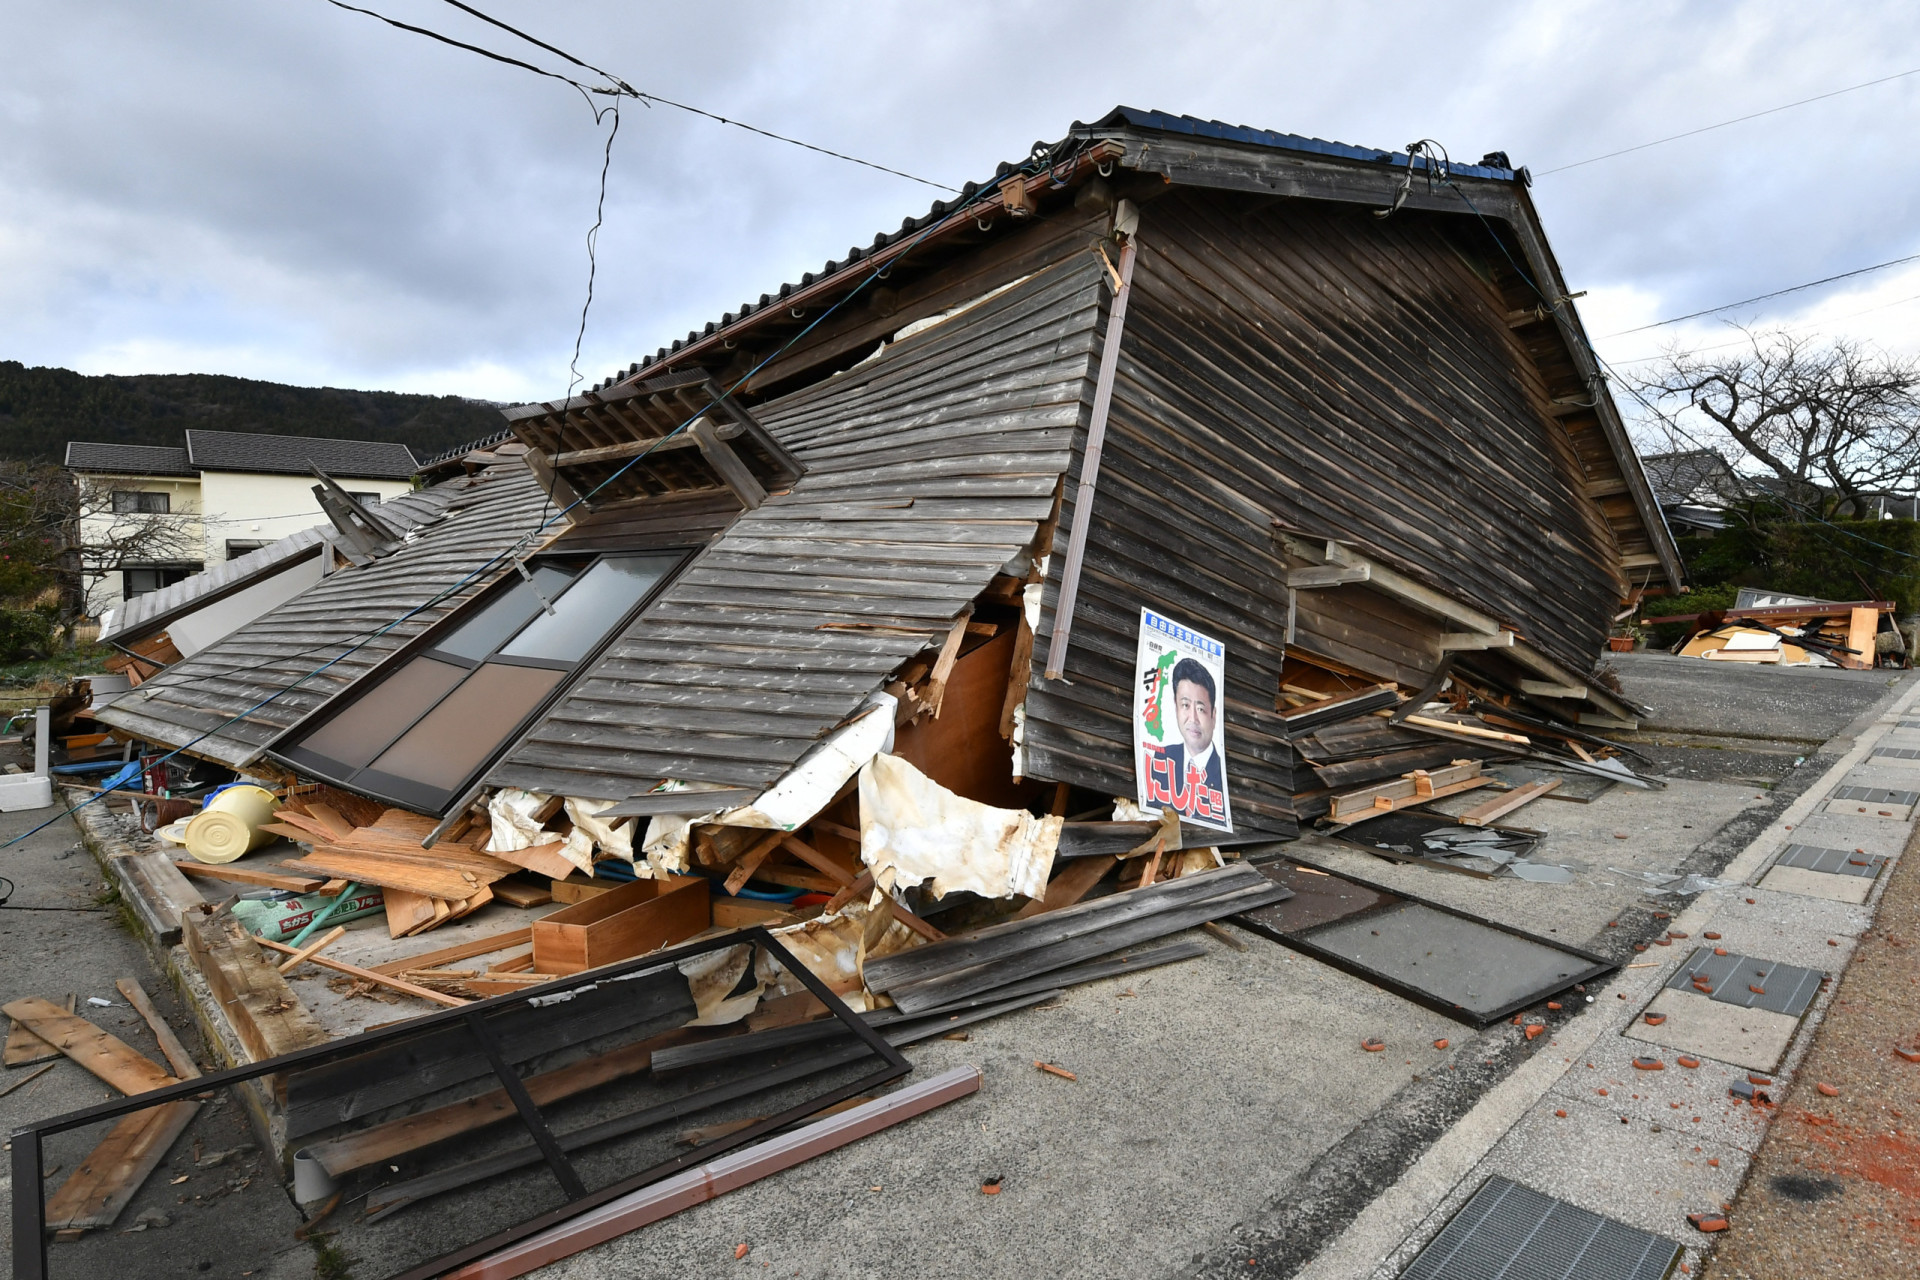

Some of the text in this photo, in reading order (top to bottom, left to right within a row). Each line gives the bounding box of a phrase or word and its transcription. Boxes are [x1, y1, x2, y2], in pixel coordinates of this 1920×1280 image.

[1144, 752, 1211, 816] にしだ
[282, 914, 309, 930] ちから
